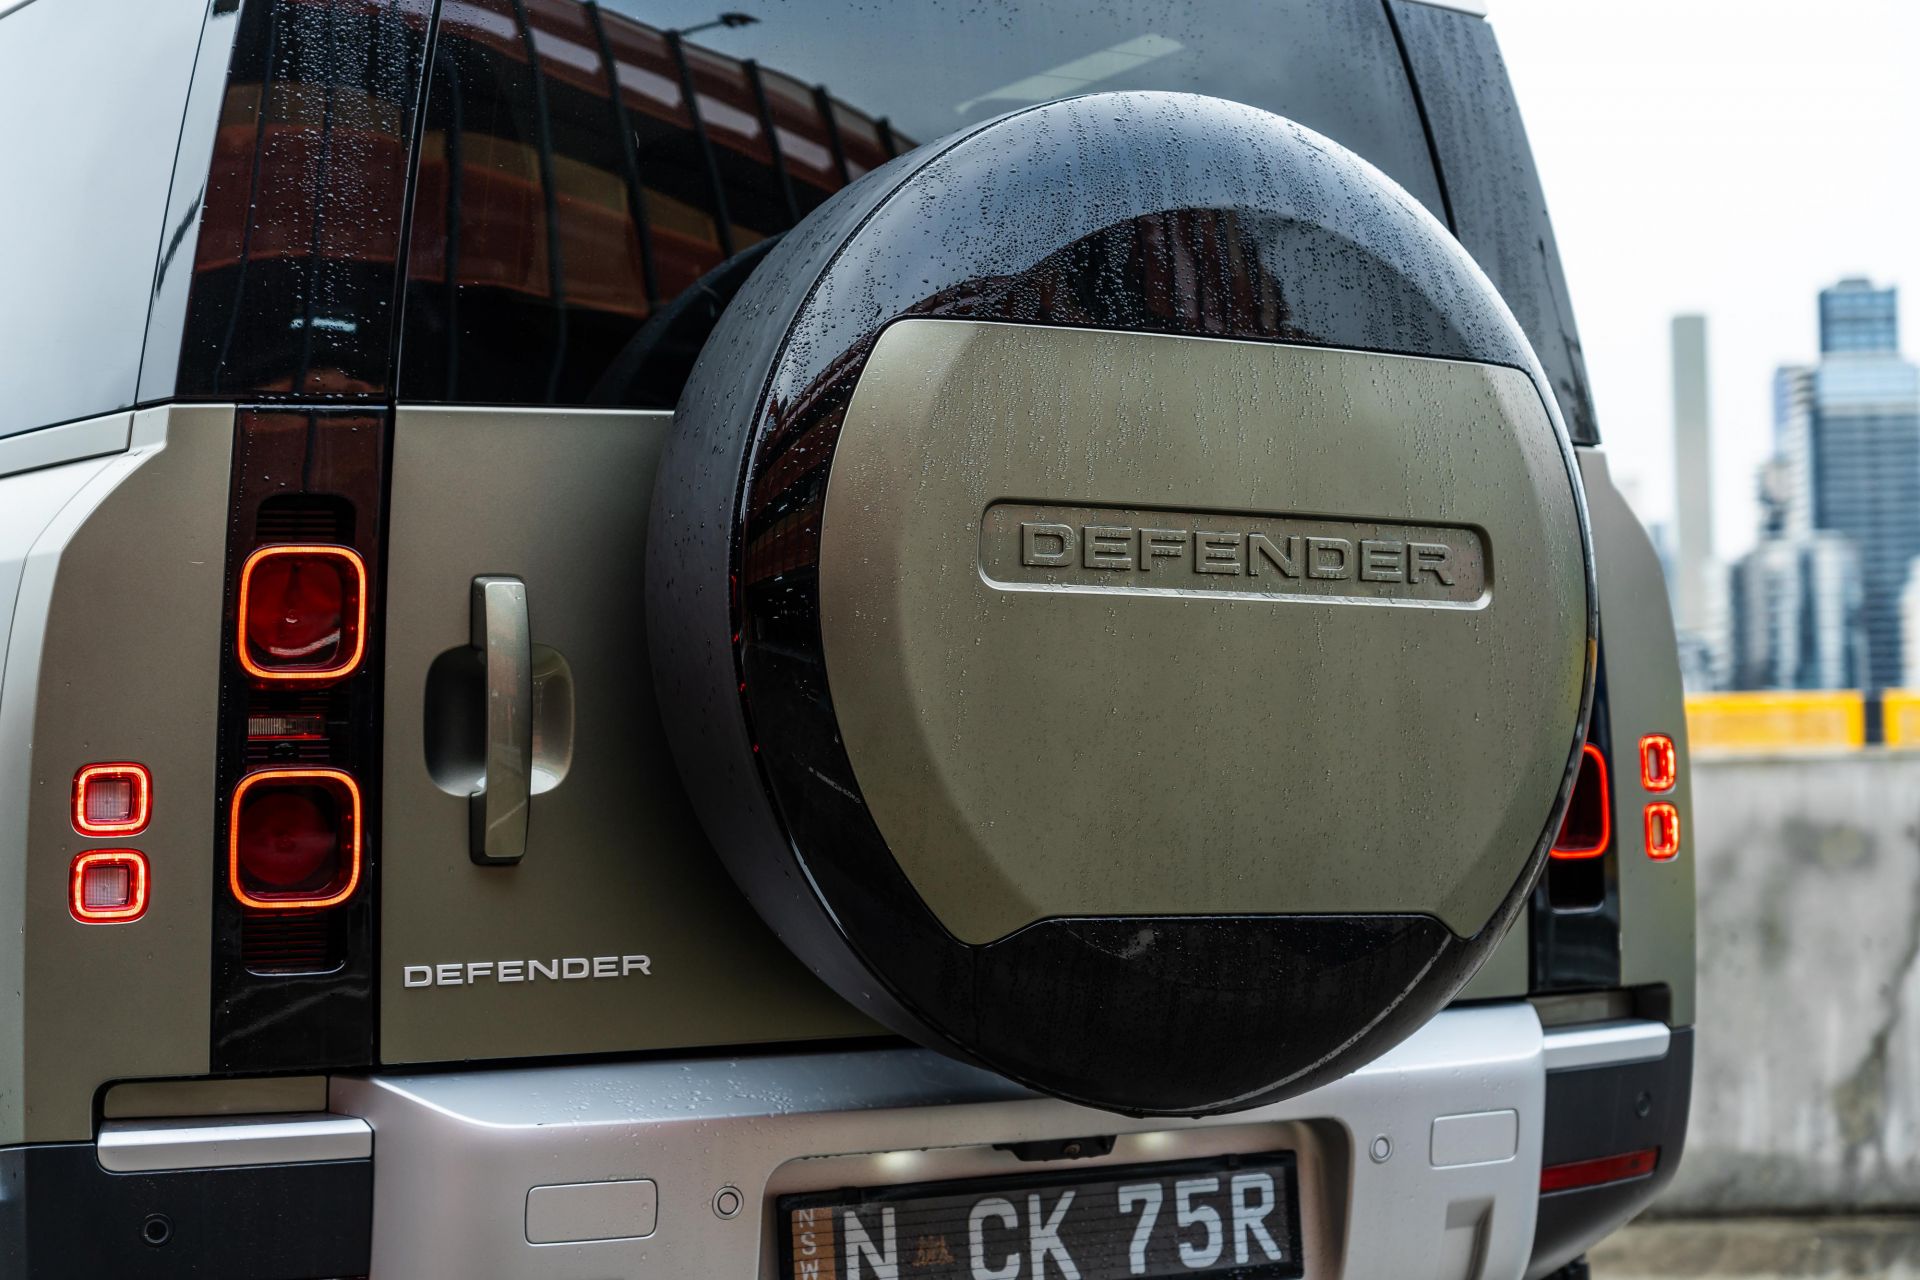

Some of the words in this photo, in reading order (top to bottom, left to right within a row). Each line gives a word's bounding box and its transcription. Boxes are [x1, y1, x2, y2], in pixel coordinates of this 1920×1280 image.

[1021, 521, 1455, 586] DEFENDER
[404, 955, 651, 988] DEFENDER
[800, 1208, 819, 1280] NSW
[1118, 1172, 1283, 1275] 75R
